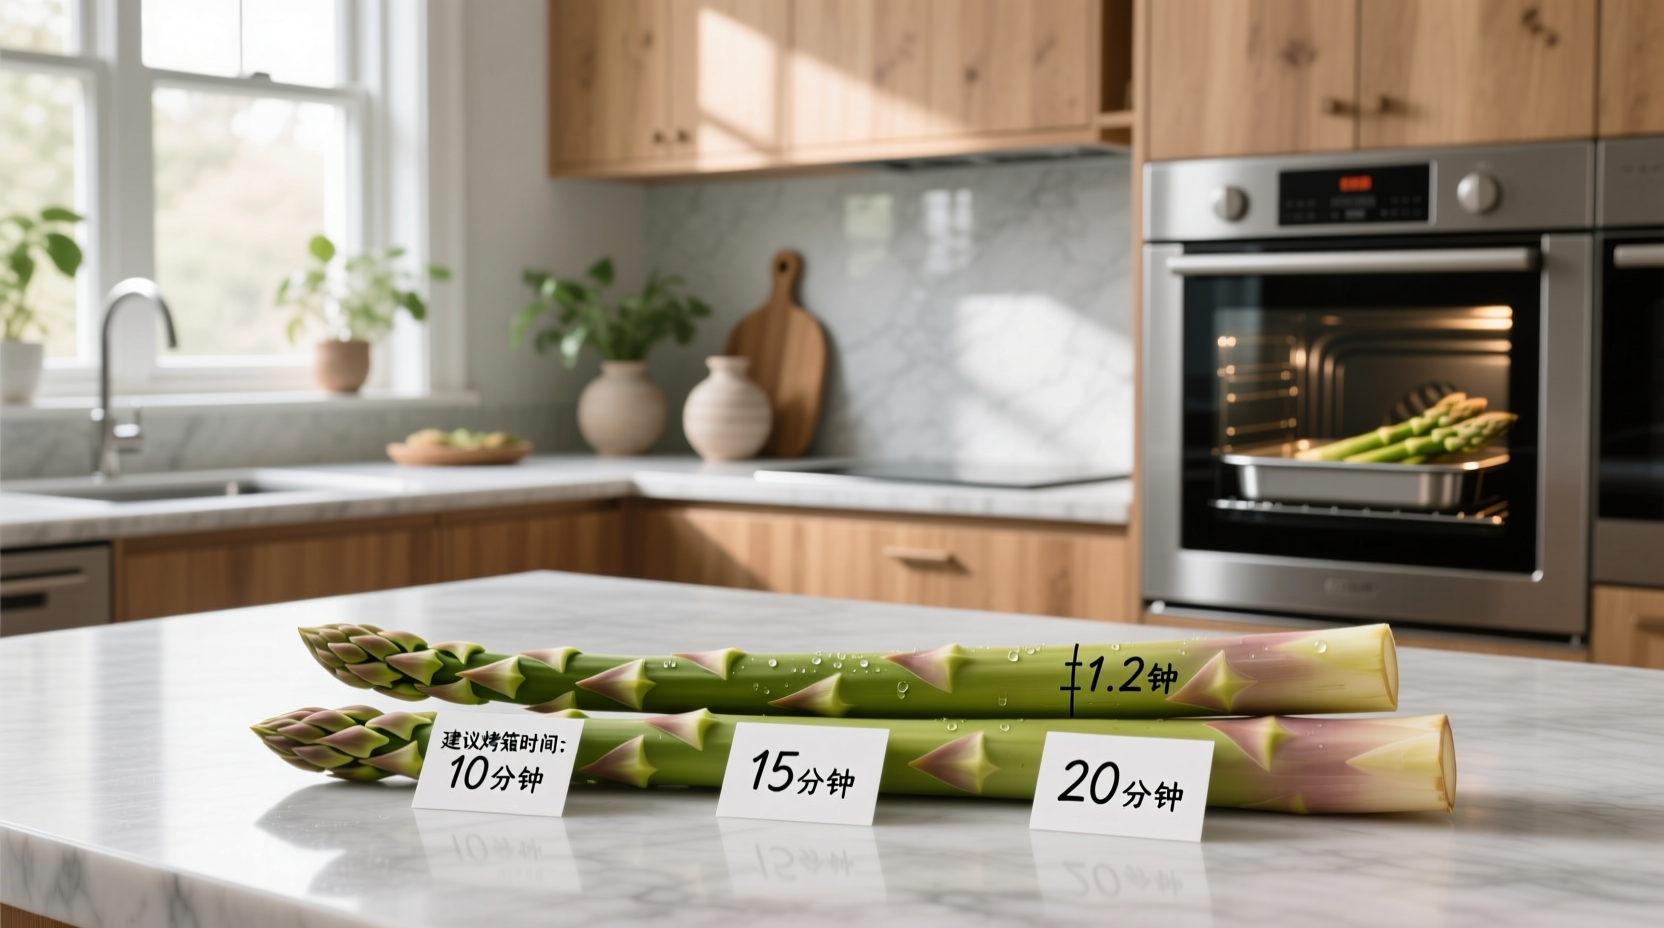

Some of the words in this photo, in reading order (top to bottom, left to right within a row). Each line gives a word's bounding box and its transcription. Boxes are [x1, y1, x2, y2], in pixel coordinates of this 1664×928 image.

[1089, 655, 1178, 695] 1.2钟
[450, 754, 544, 794] 10分钟
[752, 749, 856, 800] 15分钟
[1057, 759, 1184, 813] 20分钟
